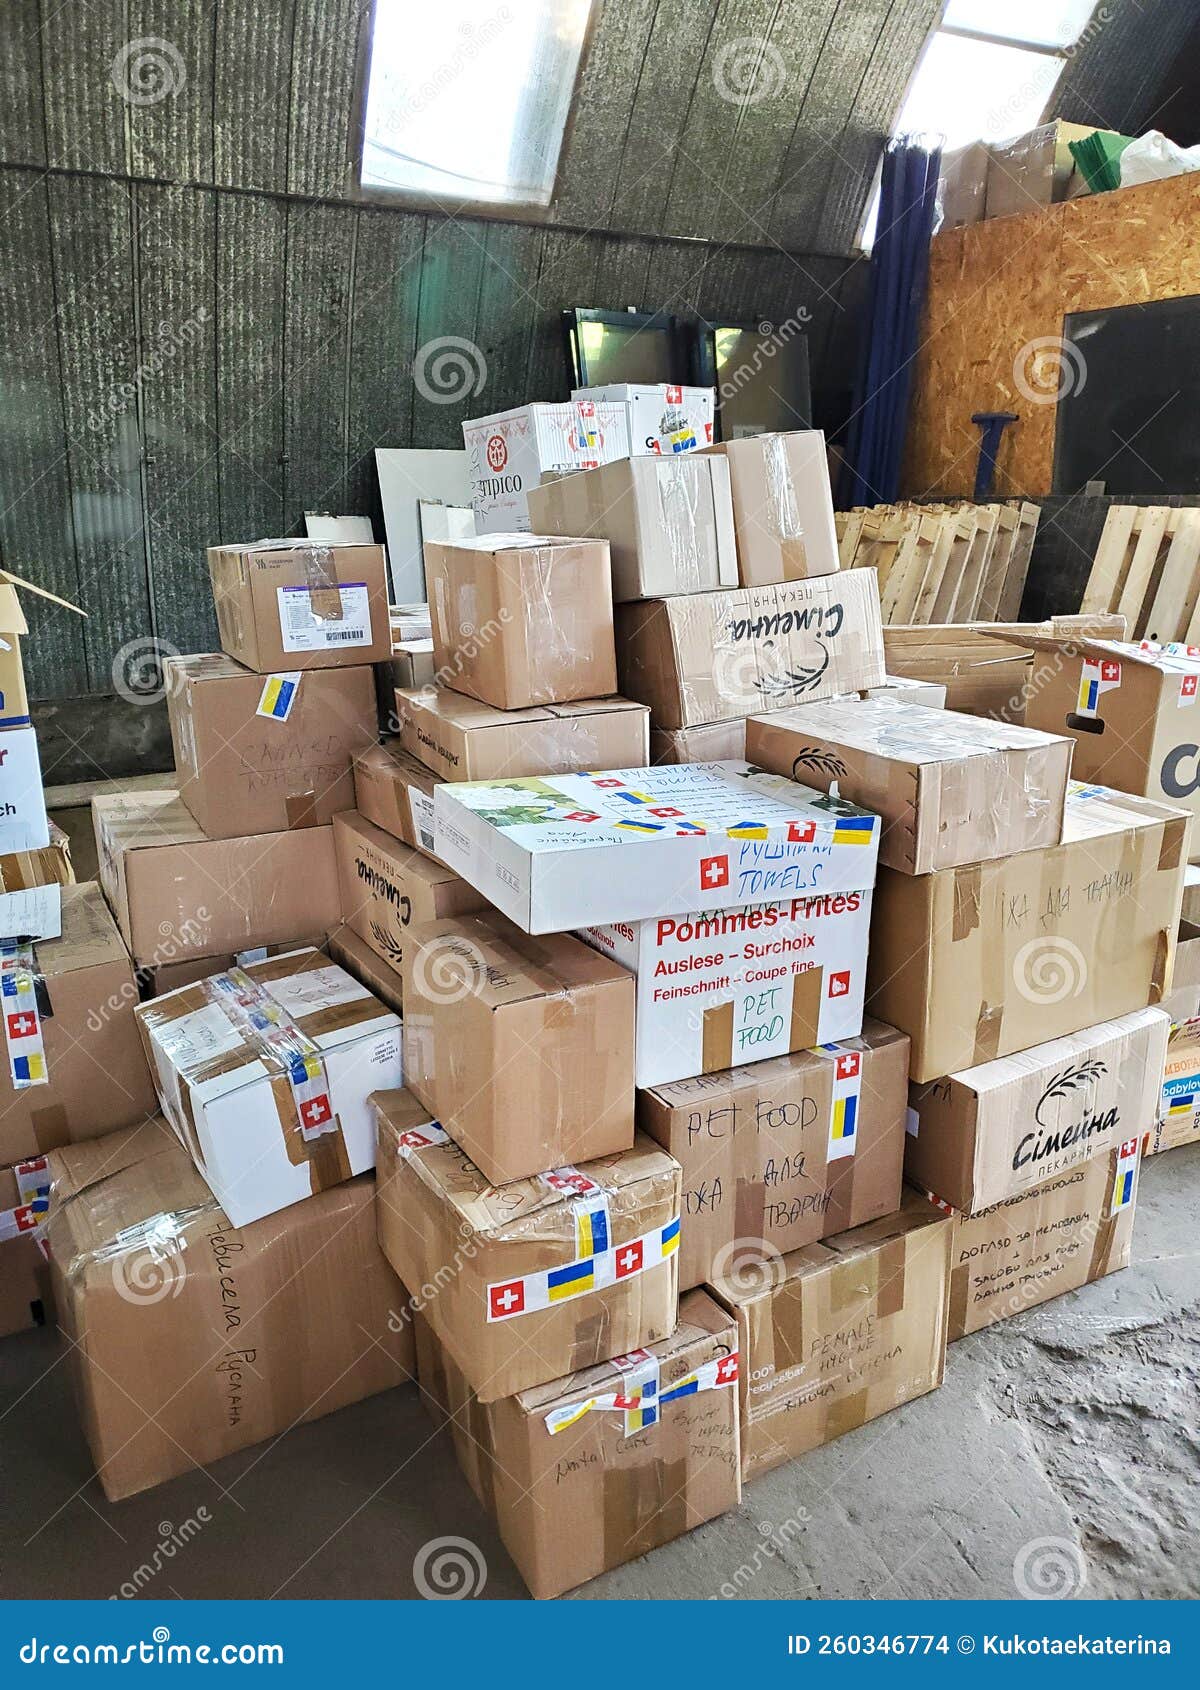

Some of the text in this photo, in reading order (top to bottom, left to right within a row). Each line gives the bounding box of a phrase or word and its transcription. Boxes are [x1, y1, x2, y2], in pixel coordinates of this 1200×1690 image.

[753, 589, 813, 607] ПЕКАРНЯ
[738, 864, 823, 897] TOWELS
[656, 893, 861, 946] Pommes-Frites
[653, 951, 724, 977] Auslese
[744, 933, 816, 960] Surchoix
[653, 975, 730, 1002] Feinschnitt
[745, 964, 788, 984] Coupe
[791, 959, 815, 975] fine
[743, 988, 783, 1023] PET
[738, 1015, 784, 1050] FOOD
[688, 1098, 818, 1146] PET FOOD
[1012, 1106, 1121, 1170] Сімейна
[1038, 1145, 1093, 1177] ПЕКАРНЯ
